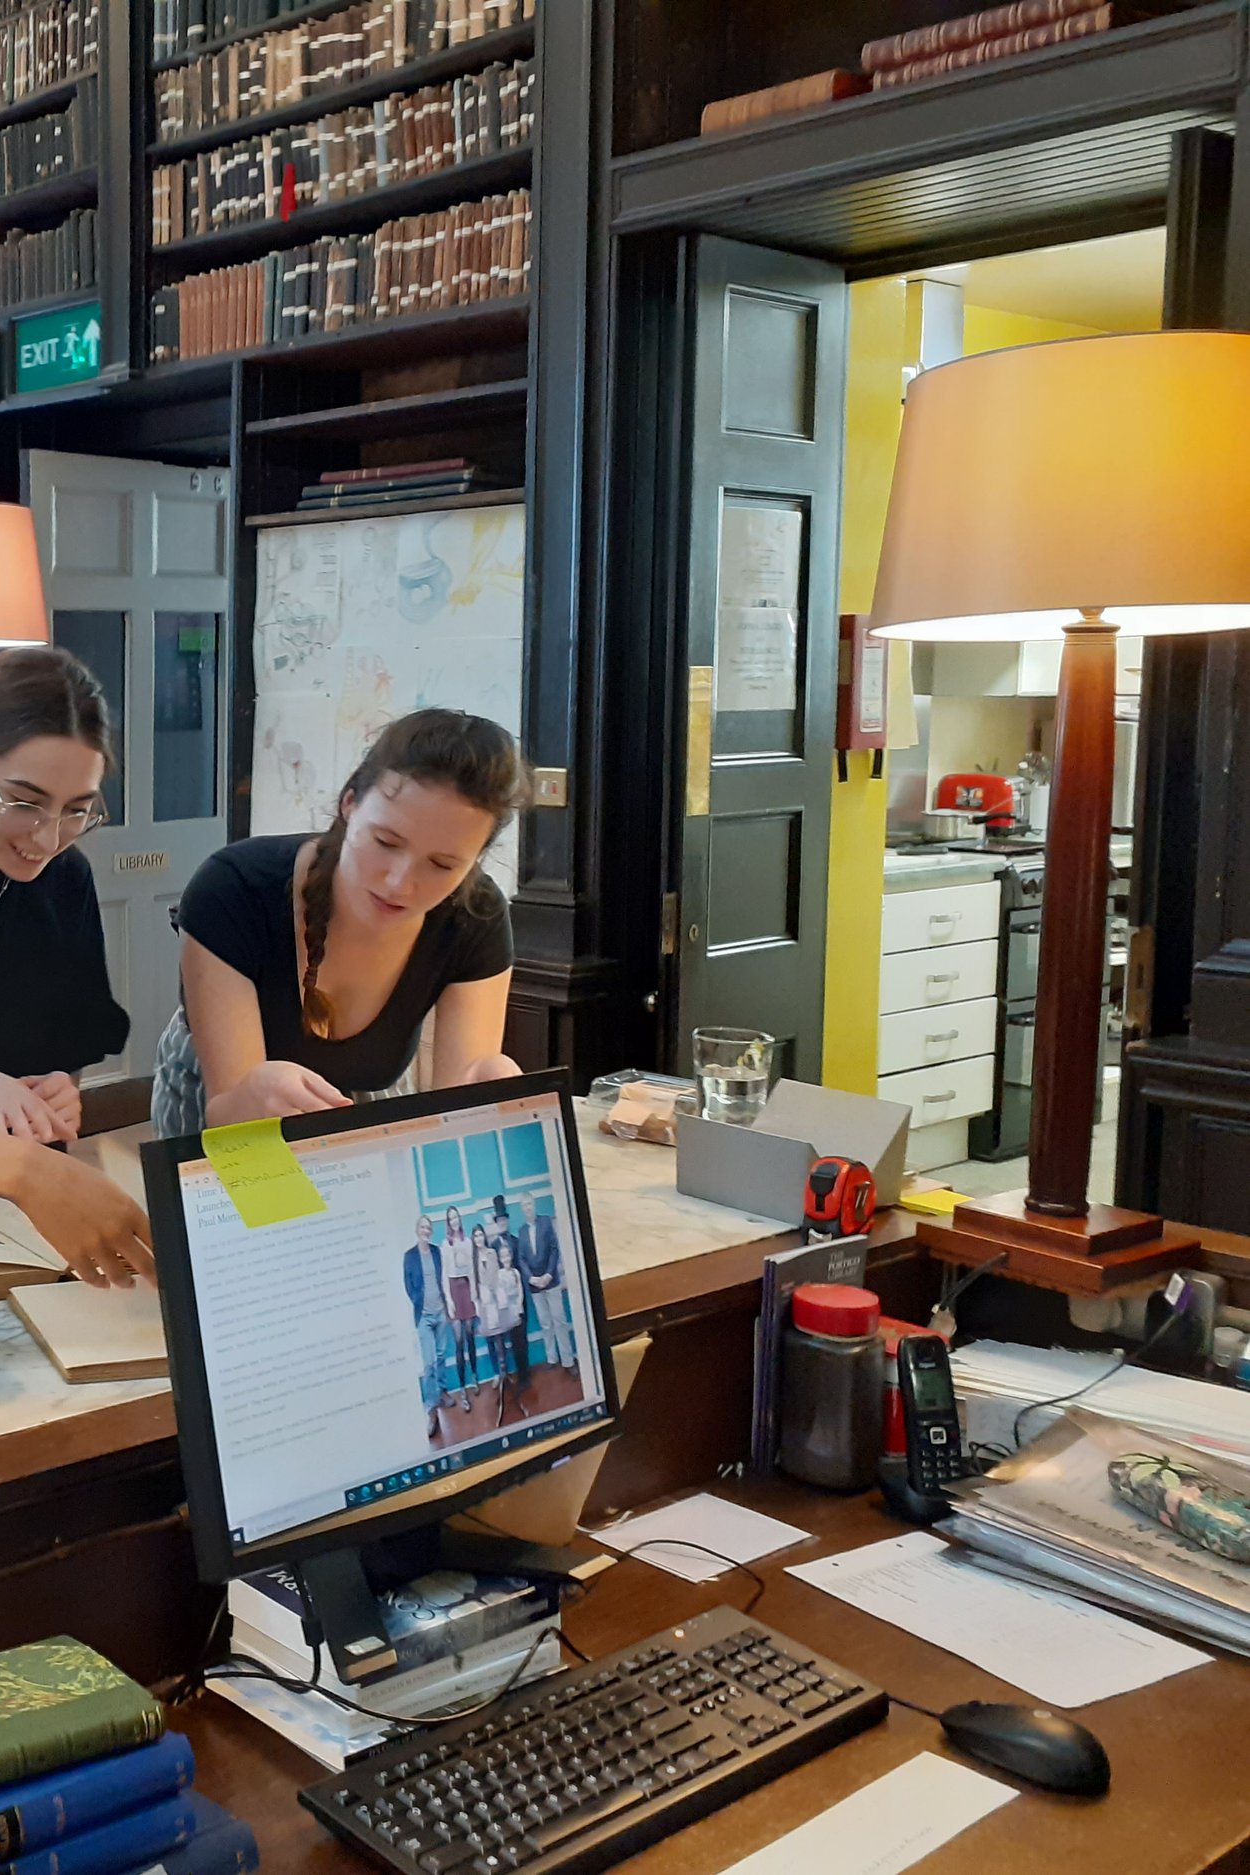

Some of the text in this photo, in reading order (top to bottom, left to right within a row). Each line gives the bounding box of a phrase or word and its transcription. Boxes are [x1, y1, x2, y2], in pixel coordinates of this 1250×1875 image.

[21, 338, 60, 369] EXIT
[119, 853, 164, 870] LIBRARY
[828, 1257, 861, 1271] PORTICO
